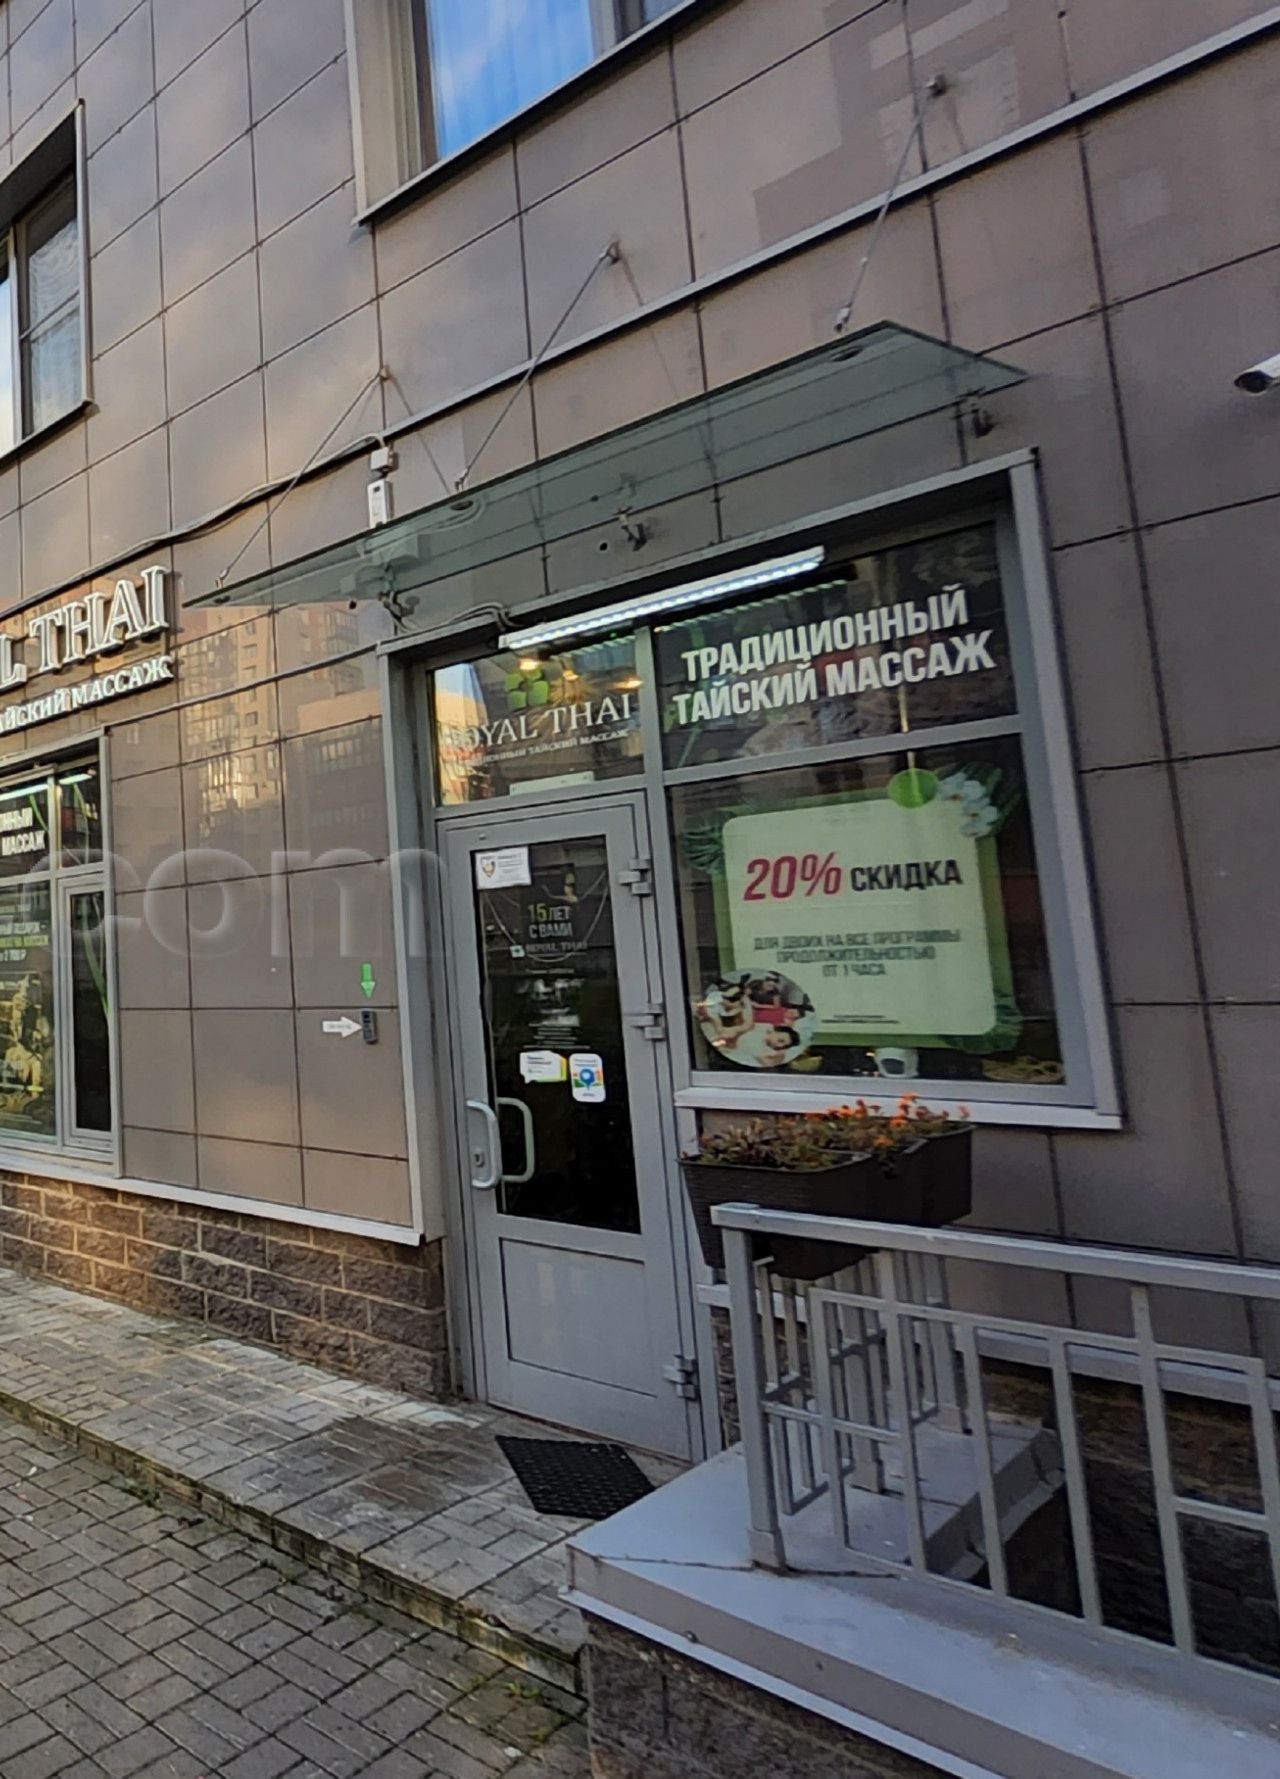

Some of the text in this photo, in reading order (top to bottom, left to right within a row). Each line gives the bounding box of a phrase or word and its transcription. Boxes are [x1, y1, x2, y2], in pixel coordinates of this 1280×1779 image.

[29, 565, 171, 674] THAI
[680, 582, 969, 683] ТРАДИЦИОННЫЙ
[71, 655, 174, 710] МАССАЖ
[671, 629, 997, 726] ТАЙСКИЙ МАССАЖ
[544, 692, 632, 735] THAI
[1, 830, 46, 857] МАССАЖ
[743, 852, 964, 901] 20% СКИДКА
[527, 902, 548, 923] 15
[529, 924, 538, 939] С
